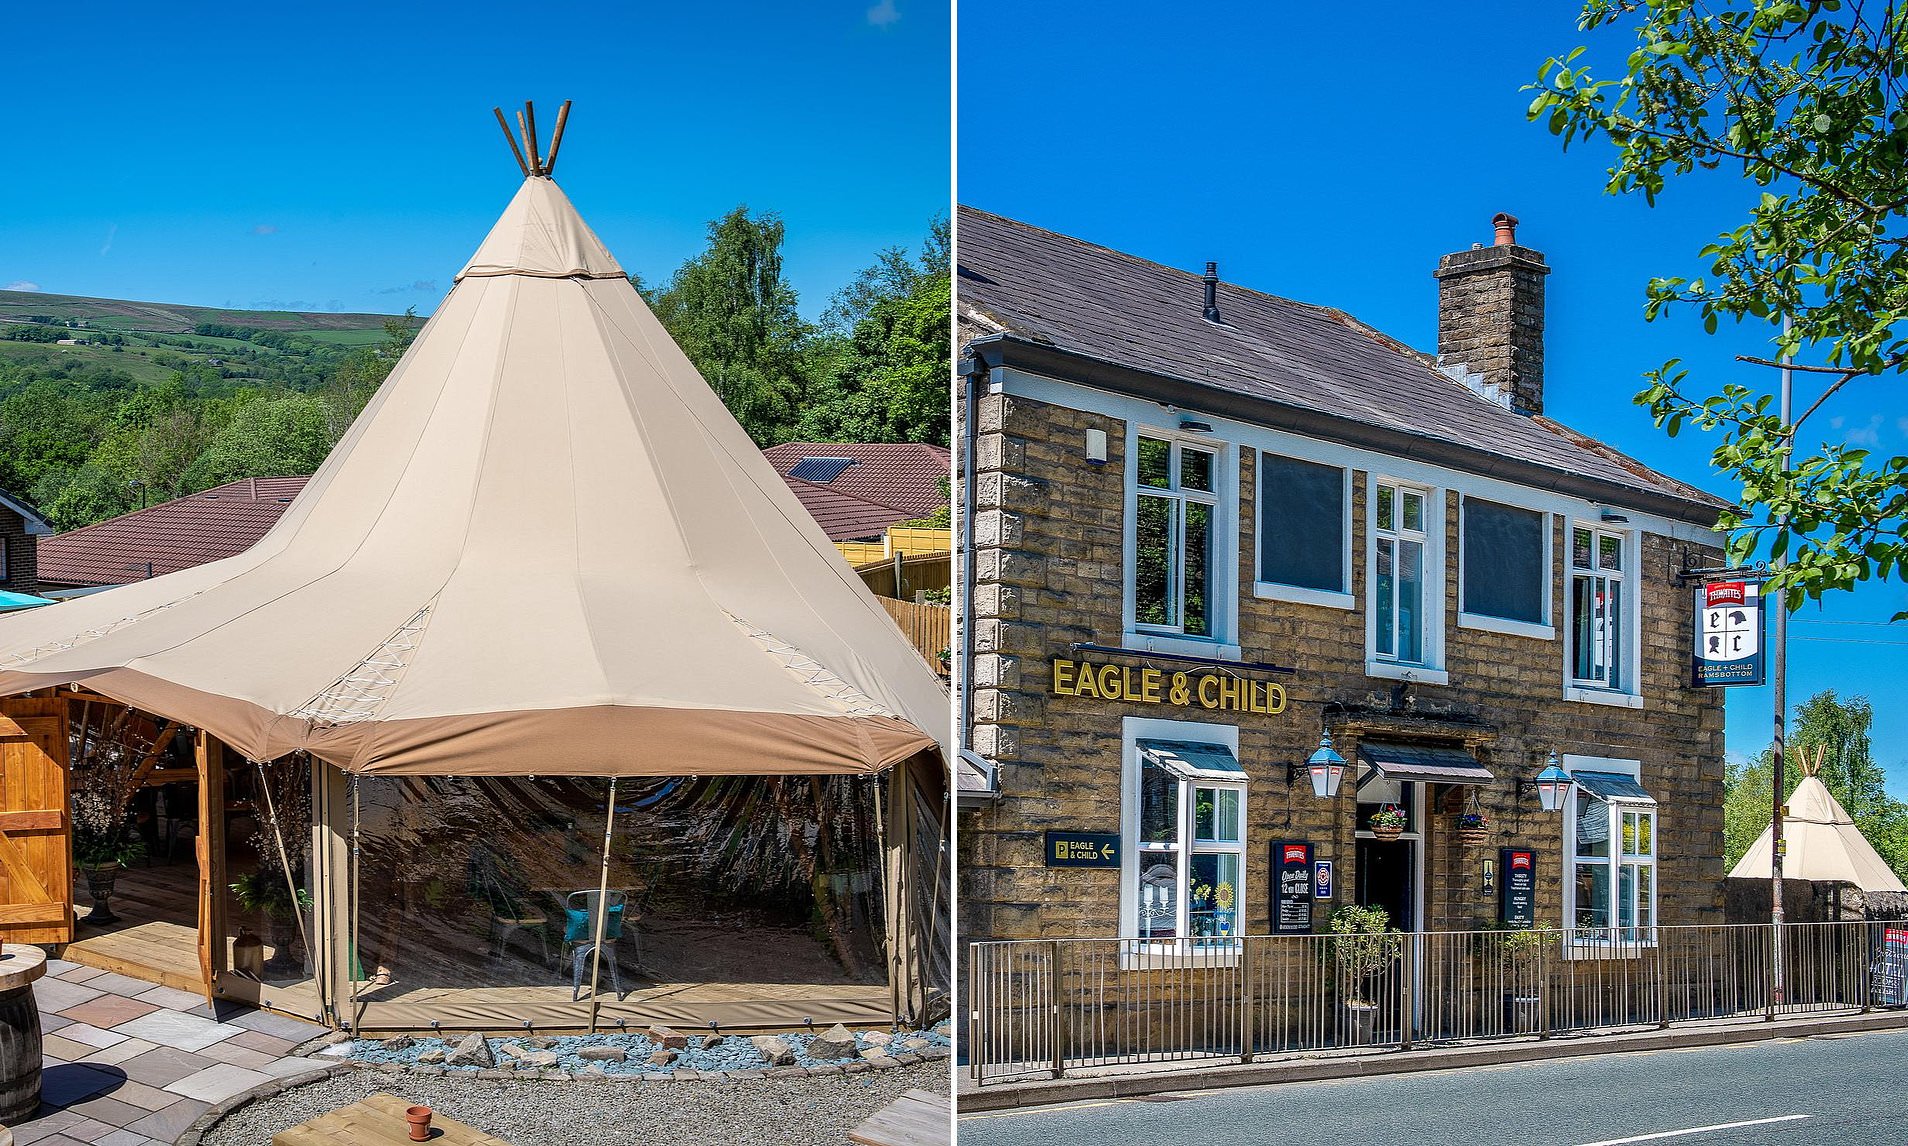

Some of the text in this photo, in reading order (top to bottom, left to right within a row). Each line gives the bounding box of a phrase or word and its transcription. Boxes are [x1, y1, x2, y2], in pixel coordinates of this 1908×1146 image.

[1710, 611, 1720, 628] e
[1698, 671, 1753, 679] RAMSBOTTOM
[1054, 658, 1287, 714] EAGLE & CHILD
[1070, 841, 1094, 850] EAGLE
[1070, 851, 1098, 860] & CHILD
